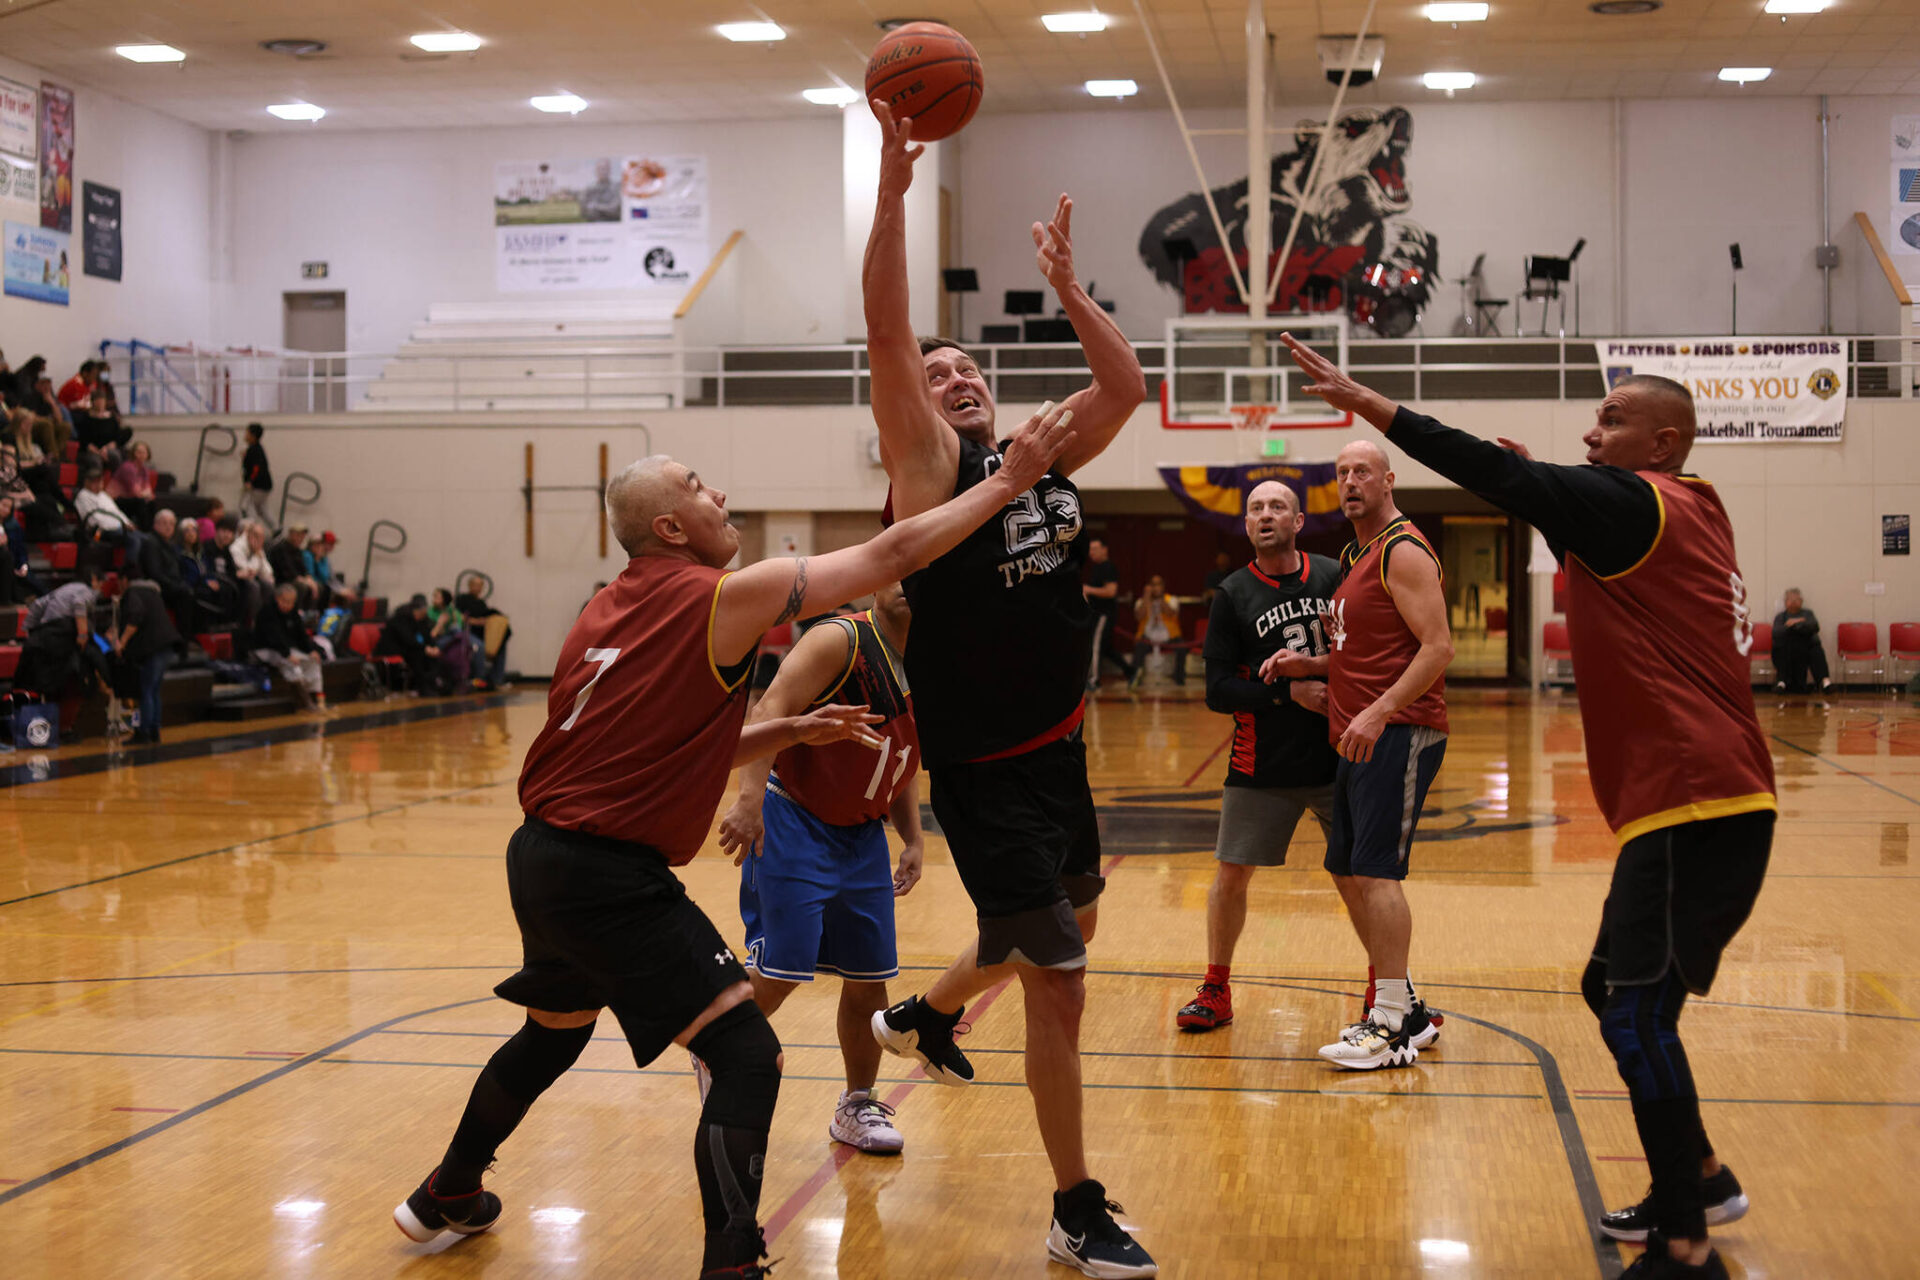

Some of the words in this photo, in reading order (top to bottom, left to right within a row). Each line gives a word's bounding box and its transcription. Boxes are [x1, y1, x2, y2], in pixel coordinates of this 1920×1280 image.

[889, 80, 925, 105] ITE
[1608, 344, 1676, 356] PLAYERS
[1694, 343, 1735, 356] FANS
[1752, 342, 1841, 355] SPONSORS
[1676, 378, 1744, 399] ANKS
[1749, 377, 1799, 400] YOU
[1696, 404, 1750, 416] ticipating
[1753, 404, 1765, 414] in
[1767, 405, 1786, 414] our
[1696, 421, 1754, 438] asketball
[1003, 487, 1083, 555] 23
[1255, 597, 1331, 638] CHILKA
[1282, 619, 1329, 657] 21
[560, 647, 621, 731] 7
